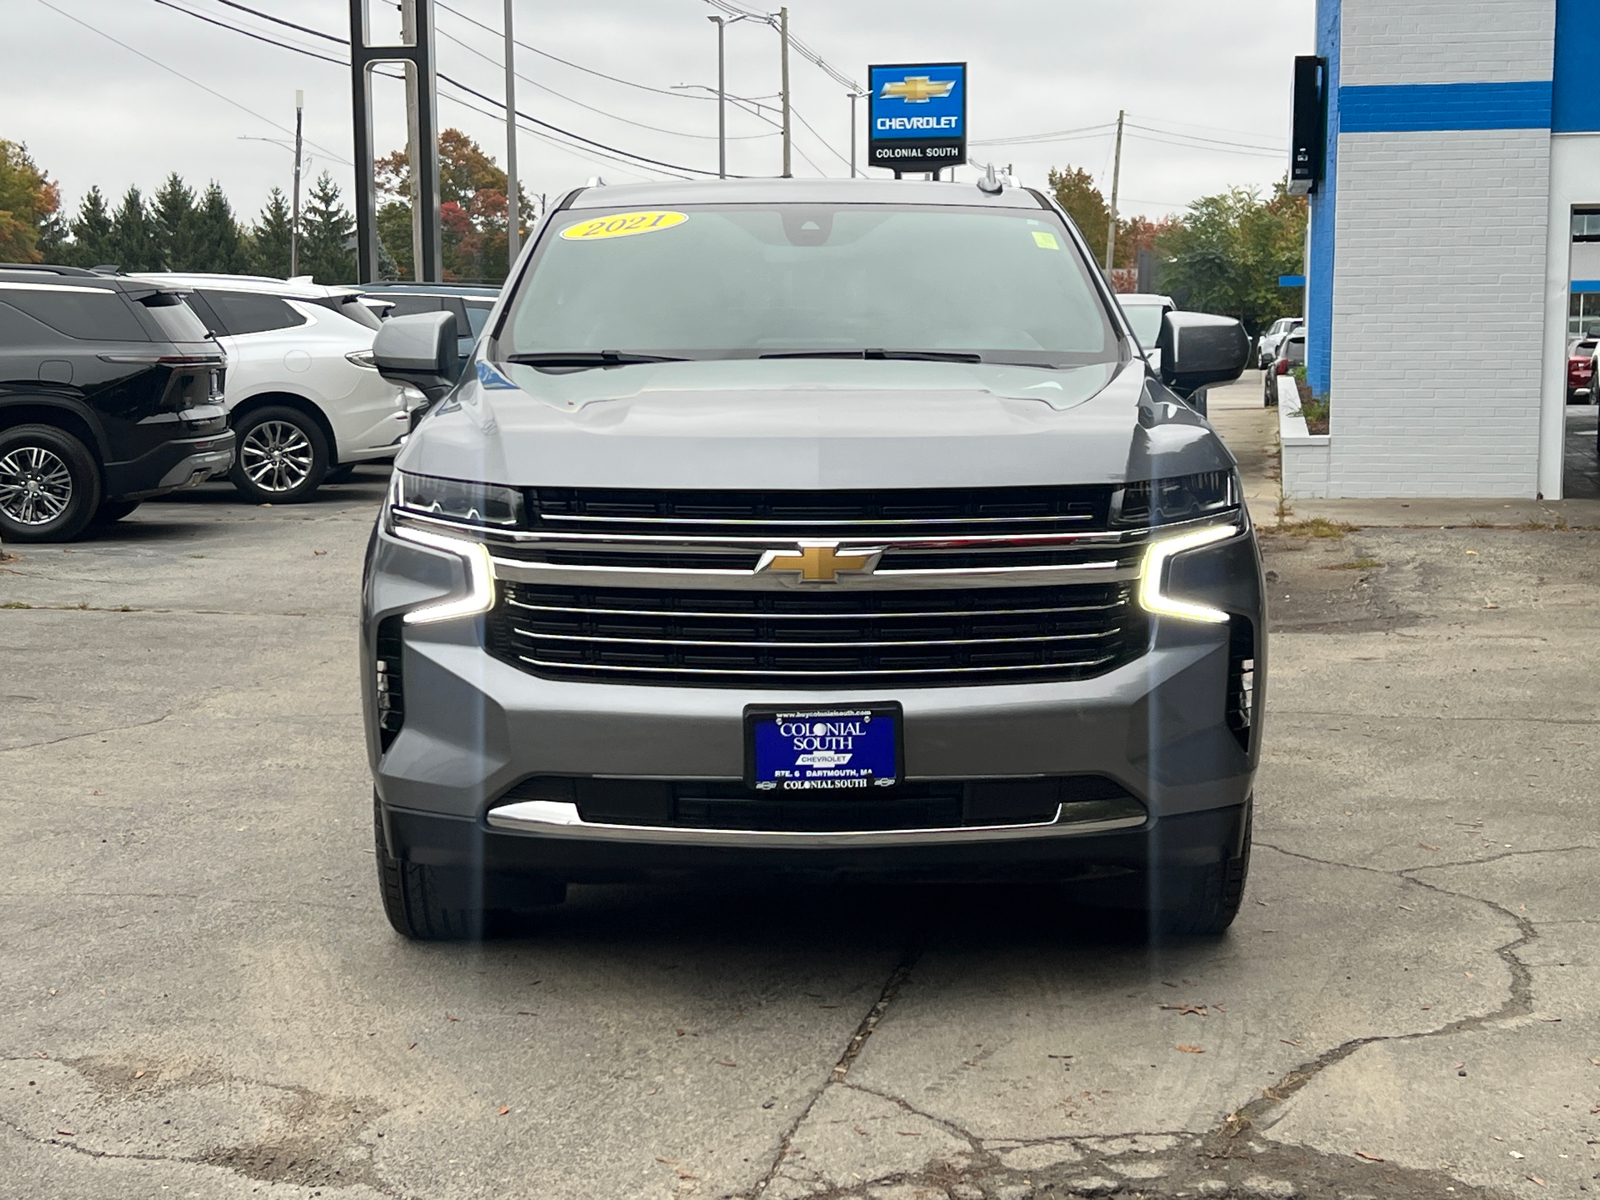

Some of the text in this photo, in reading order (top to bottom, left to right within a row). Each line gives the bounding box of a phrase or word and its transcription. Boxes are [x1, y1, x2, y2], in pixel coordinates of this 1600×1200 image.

[877, 117, 958, 129] CHEVROLET
[876, 147, 958, 158] COLONIAL SOUTH
[582, 214, 666, 236] 2021
[780, 722, 866, 737] COLONIAL
[793, 737, 853, 750] SOUTH
[806, 769, 859, 778] DARTMOUTH,
[784, 778, 867, 790] COLONIAL SOUTH
